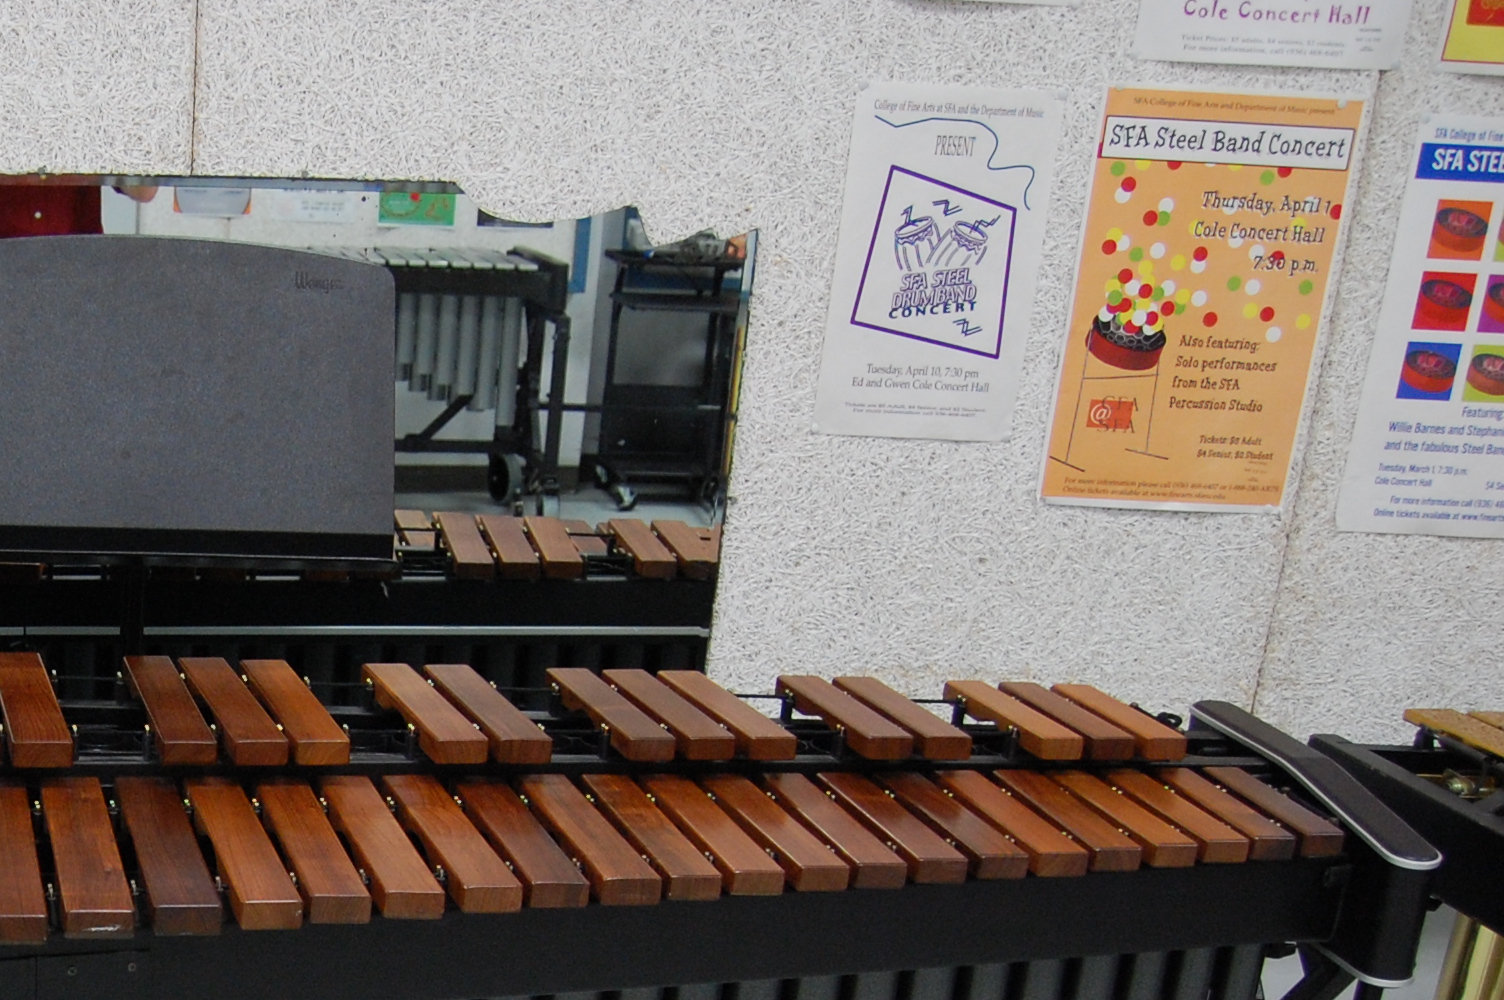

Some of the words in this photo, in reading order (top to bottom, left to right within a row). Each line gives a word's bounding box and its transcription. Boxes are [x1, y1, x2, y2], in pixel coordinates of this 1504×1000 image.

[1183, 0, 1229, 20] Cole
[1238, 0, 1321, 22] Concert
[1328, 5, 1371, 25] Hall
[874, 99, 897, 113] College
[899, 102, 905, 111] of
[907, 102, 921, 112] Fine
[922, 103, 935, 113] Arts
[937, 104, 943, 113] at
[944, 103, 956, 113] SFA
[957, 104, 969, 114] and
[970, 105, 980, 115] the
[981, 105, 1016, 118] Department
[1018, 107, 1025, 117] of
[1026, 107, 1044, 118] Music
[934, 135, 977, 157] PRESENT
[1108, 123, 1150, 148] SFA
[1153, 126, 1206, 150] Steel
[1211, 130, 1266, 154] Band
[1269, 133, 1346, 159] Concert
[1432, 148, 1464, 171] SFA
[1202, 190, 1275, 216] Thursday,
[1280, 195, 1322, 217] April
[1194, 221, 1226, 238] Cole
[1230, 222, 1288, 242] Concert
[1291, 225, 1325, 243] Hall
[1253, 255, 1285, 271] 7:30
[1289, 258, 1318, 277] p.m.
[900, 272, 928, 292] SFA
[931, 268, 972, 288] STEEL
[889, 301, 977, 319] CONCERT
[1179, 335, 1203, 348] Also
[867, 363, 903, 378] Tuesday,
[905, 365, 928, 379] April
[945, 366, 962, 378] 7:30
[964, 370, 979, 381] pm
[1175, 355, 1199, 368] Solo
[1201, 357, 1277, 372] performances
[852, 376, 863, 387] Ed
[866, 377, 882, 388] and
[884, 378, 910, 389] Gwen
[912, 379, 932, 390] Cole
[934, 380, 969, 392] Concert
[970, 381, 990, 393] Hall
[1172, 375, 1197, 389] from
[1200, 377, 1217, 390] the
[1218, 378, 1240, 391] SFA
[1169, 396, 1226, 411] Percussion
[1228, 399, 1263, 413] Studio
[1389, 421, 1412, 433] Willie
[1414, 422, 1445, 434] Barnes
[1448, 425, 1465, 436] and
[1384, 440, 1401, 451] and
[1404, 441, 1418, 452] the
[1420, 441, 1459, 454] fabulous
[1461, 443, 1484, 455] Steel
[1408, 464, 1430, 473] March
